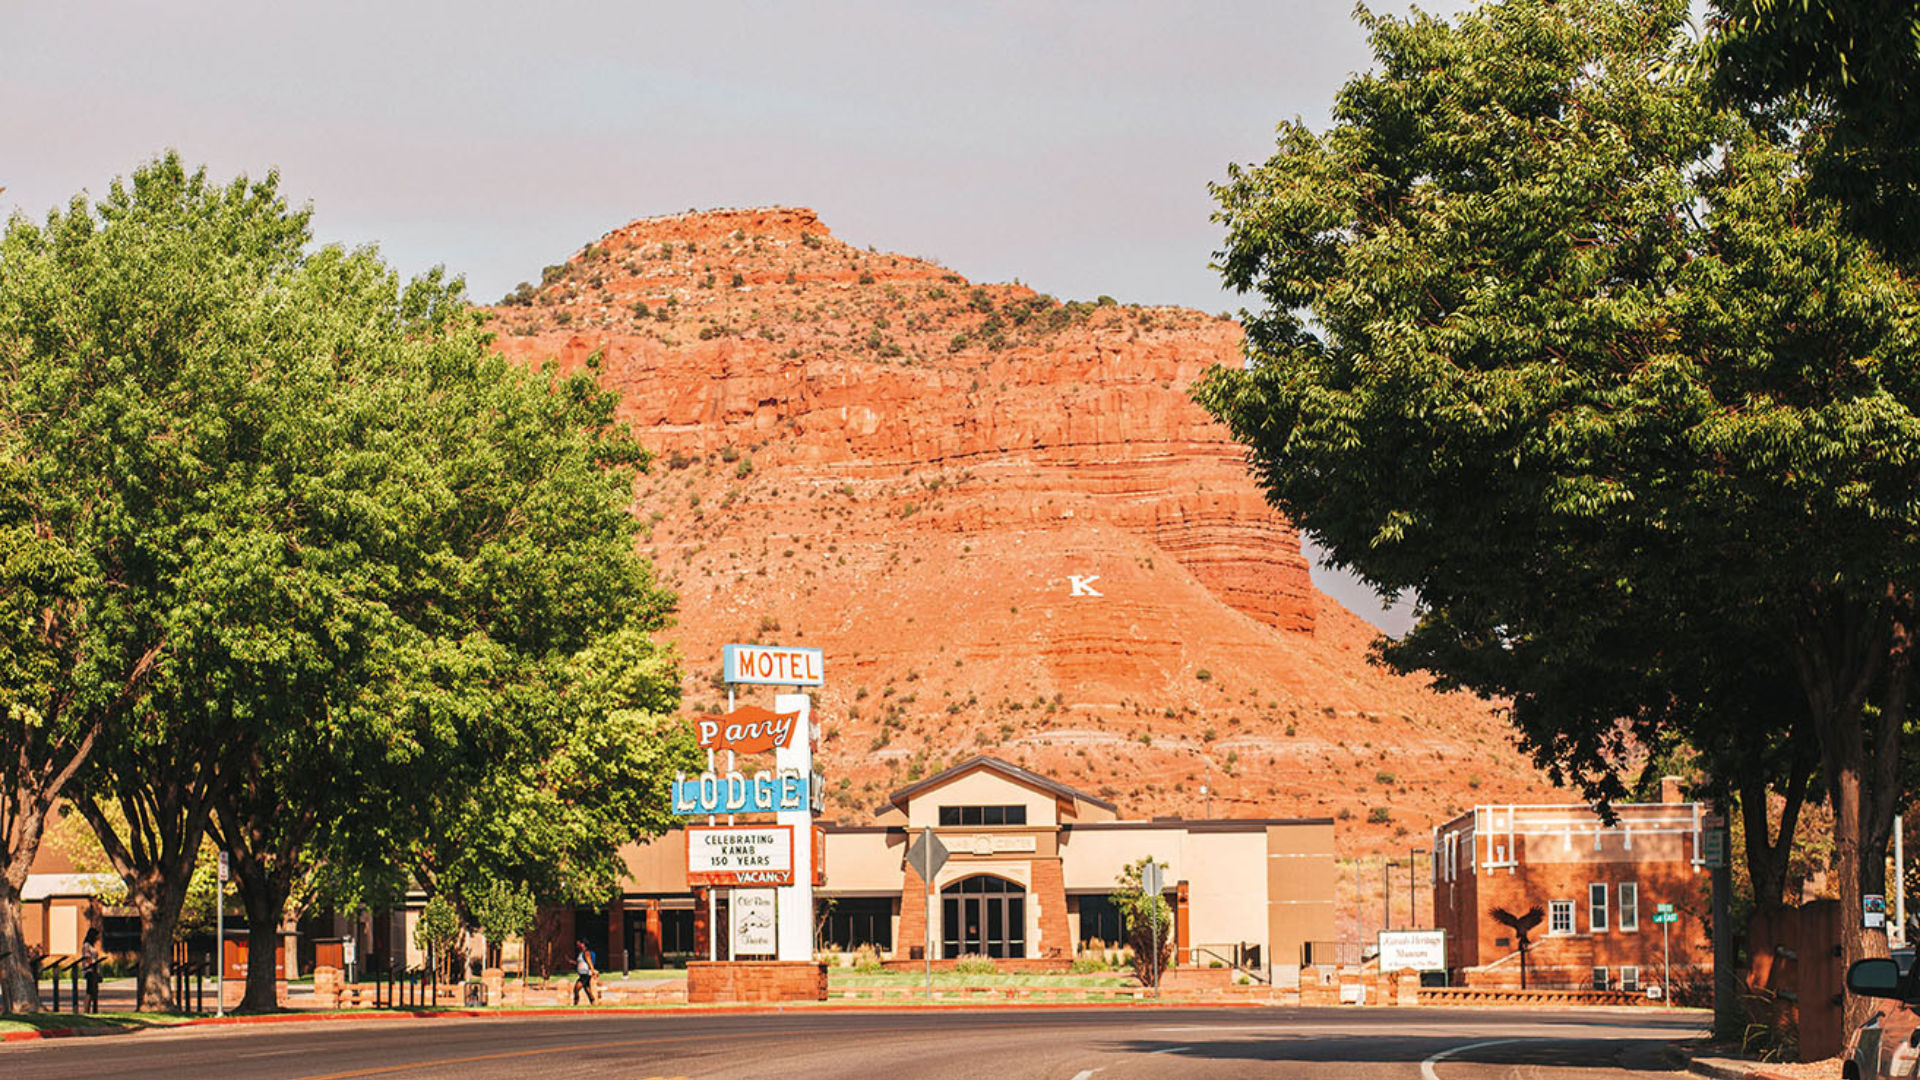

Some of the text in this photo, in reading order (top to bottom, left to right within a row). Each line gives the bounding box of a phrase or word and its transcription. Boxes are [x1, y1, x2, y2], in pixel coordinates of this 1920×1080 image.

[1067, 574, 1104, 597] K
[739, 651, 819, 679] MOTEL
[698, 716, 793, 746] Parry
[675, 767, 801, 811] LODGE
[704, 834, 774, 845] CELEBRATING
[721, 846, 756, 855] KANAB
[711, 855, 770, 866] 150 YEARS
[735, 871, 791, 883] VACANCY
